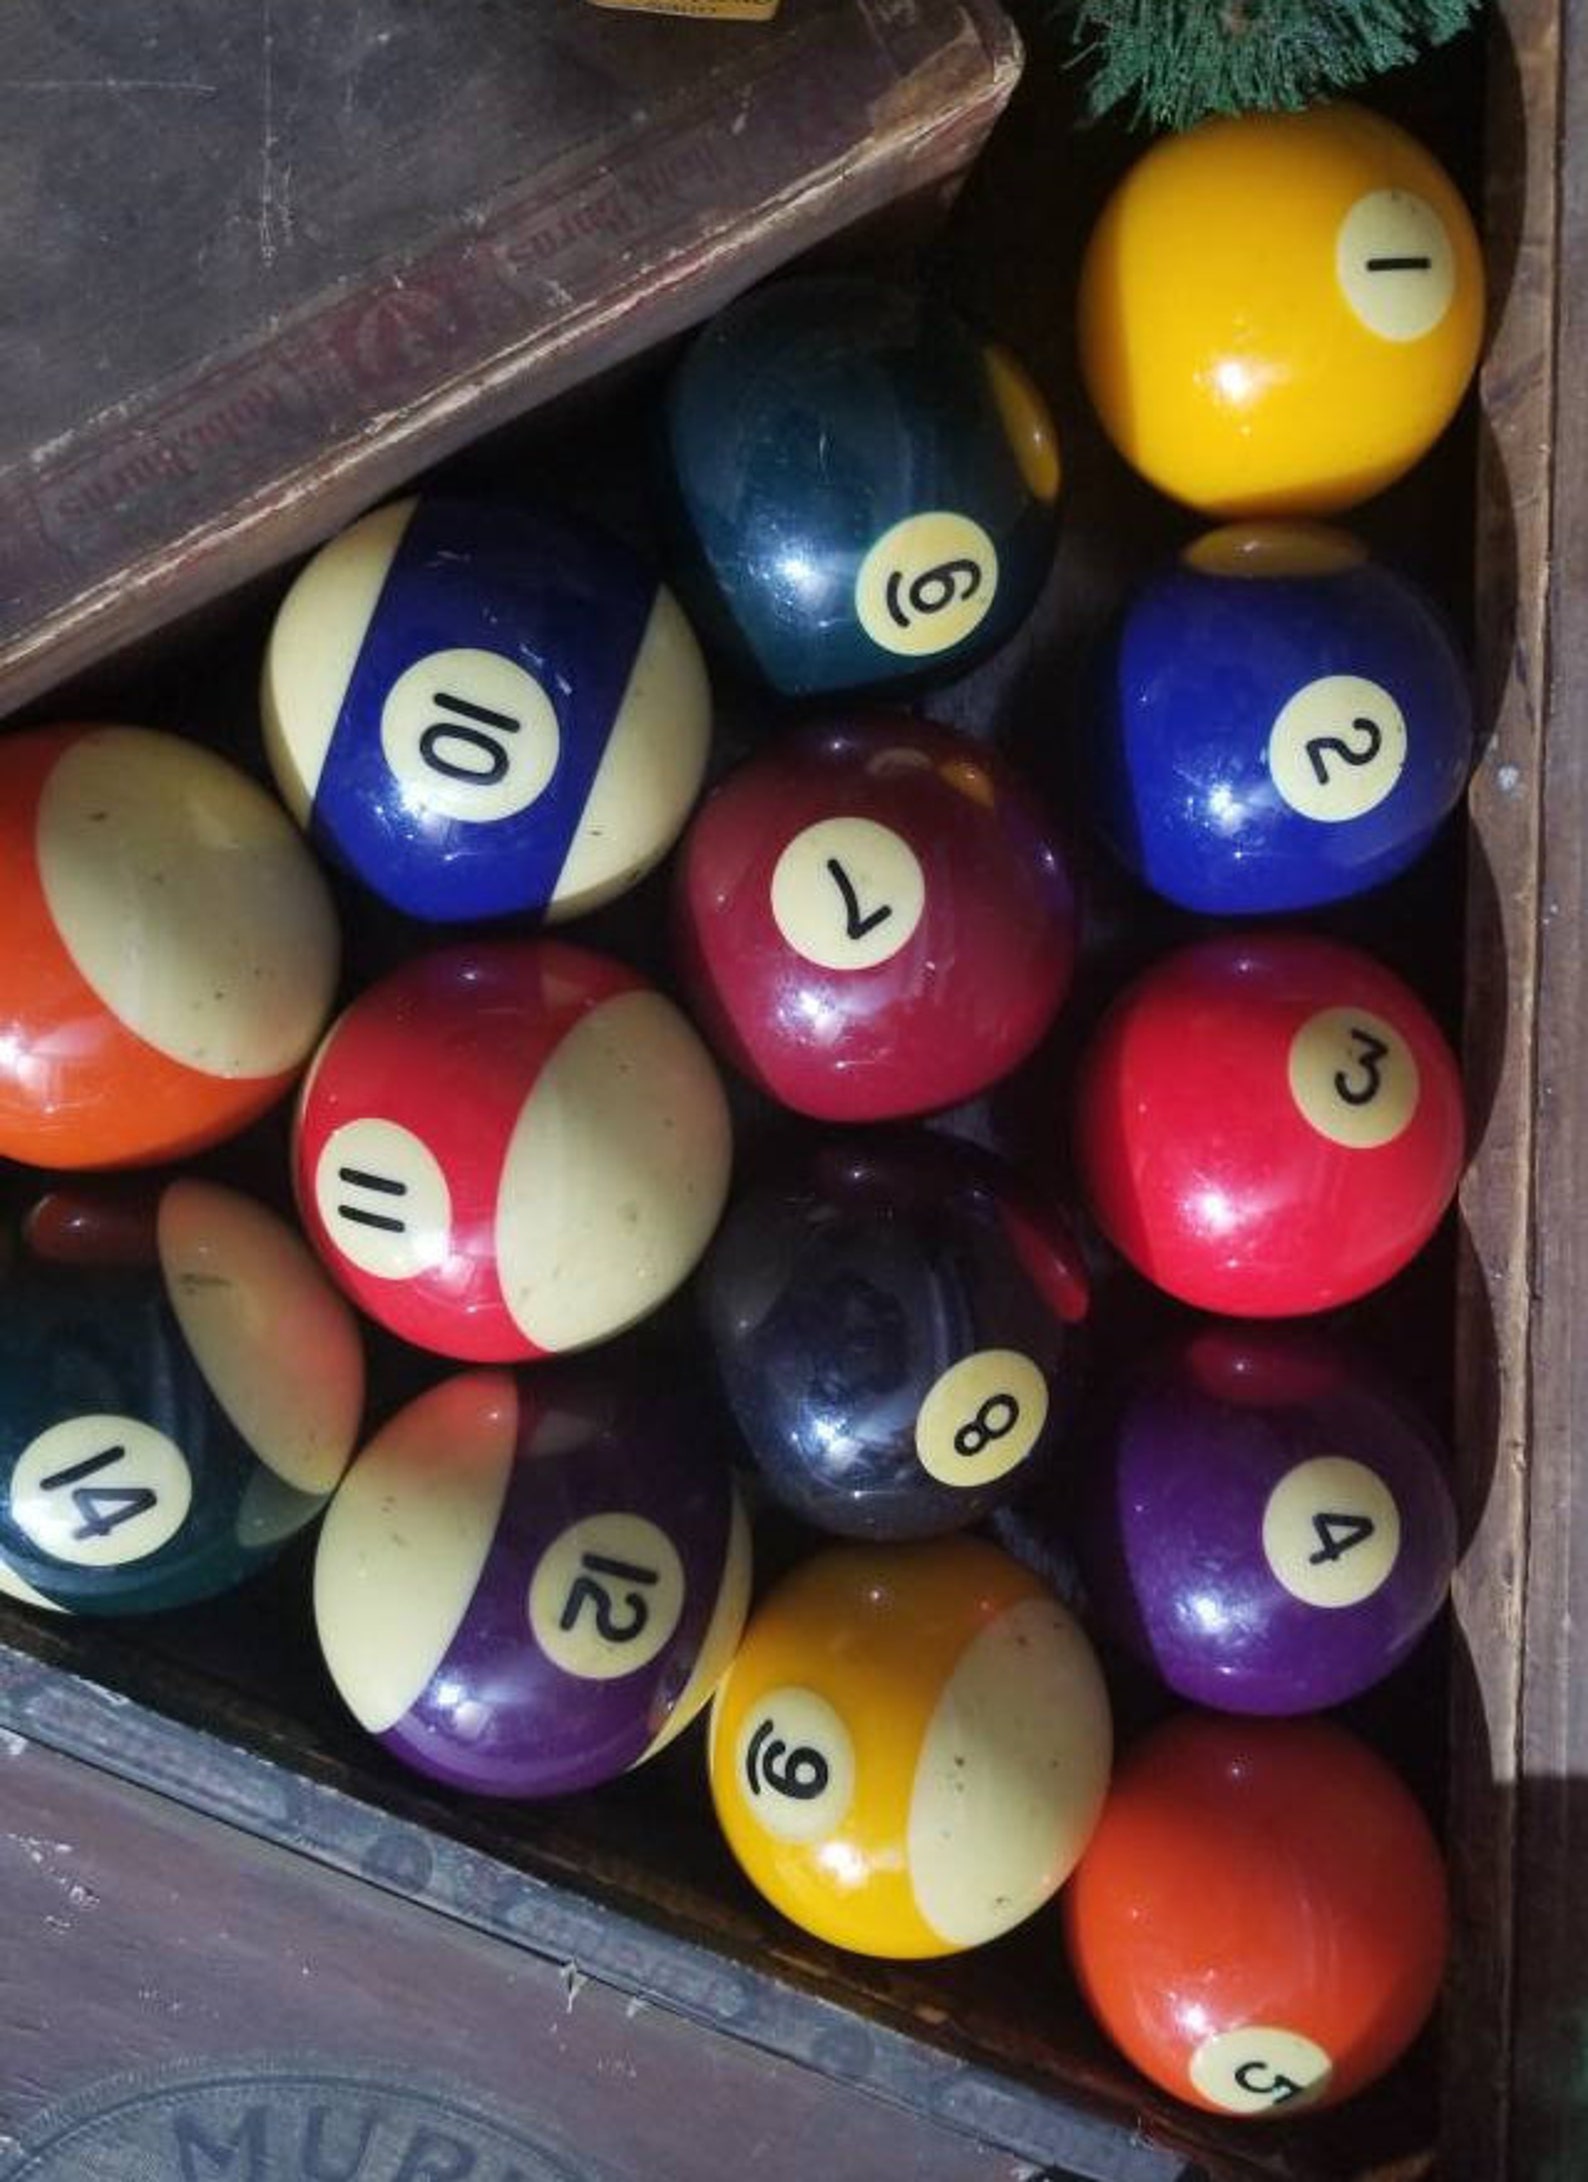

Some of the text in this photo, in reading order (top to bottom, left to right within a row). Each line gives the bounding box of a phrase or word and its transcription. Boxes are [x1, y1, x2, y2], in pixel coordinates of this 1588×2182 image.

[1367, 258, 1432, 272] 1
[887, 559, 981, 629] 6
[419, 692, 521, 786] 10
[1306, 718, 1382, 785] 2
[827, 858, 892, 940] 7
[1335, 1029, 1389, 1107] 3
[338, 1167, 407, 1233] 11
[954, 1393, 1020, 1457] 8
[40, 1445, 158, 1540] 14
[1309, 1513, 1375, 1565] 4
[560, 1552, 659, 1643] 12
[747, 1719, 829, 1800] 9
[1234, 2061, 1303, 2105] 5
